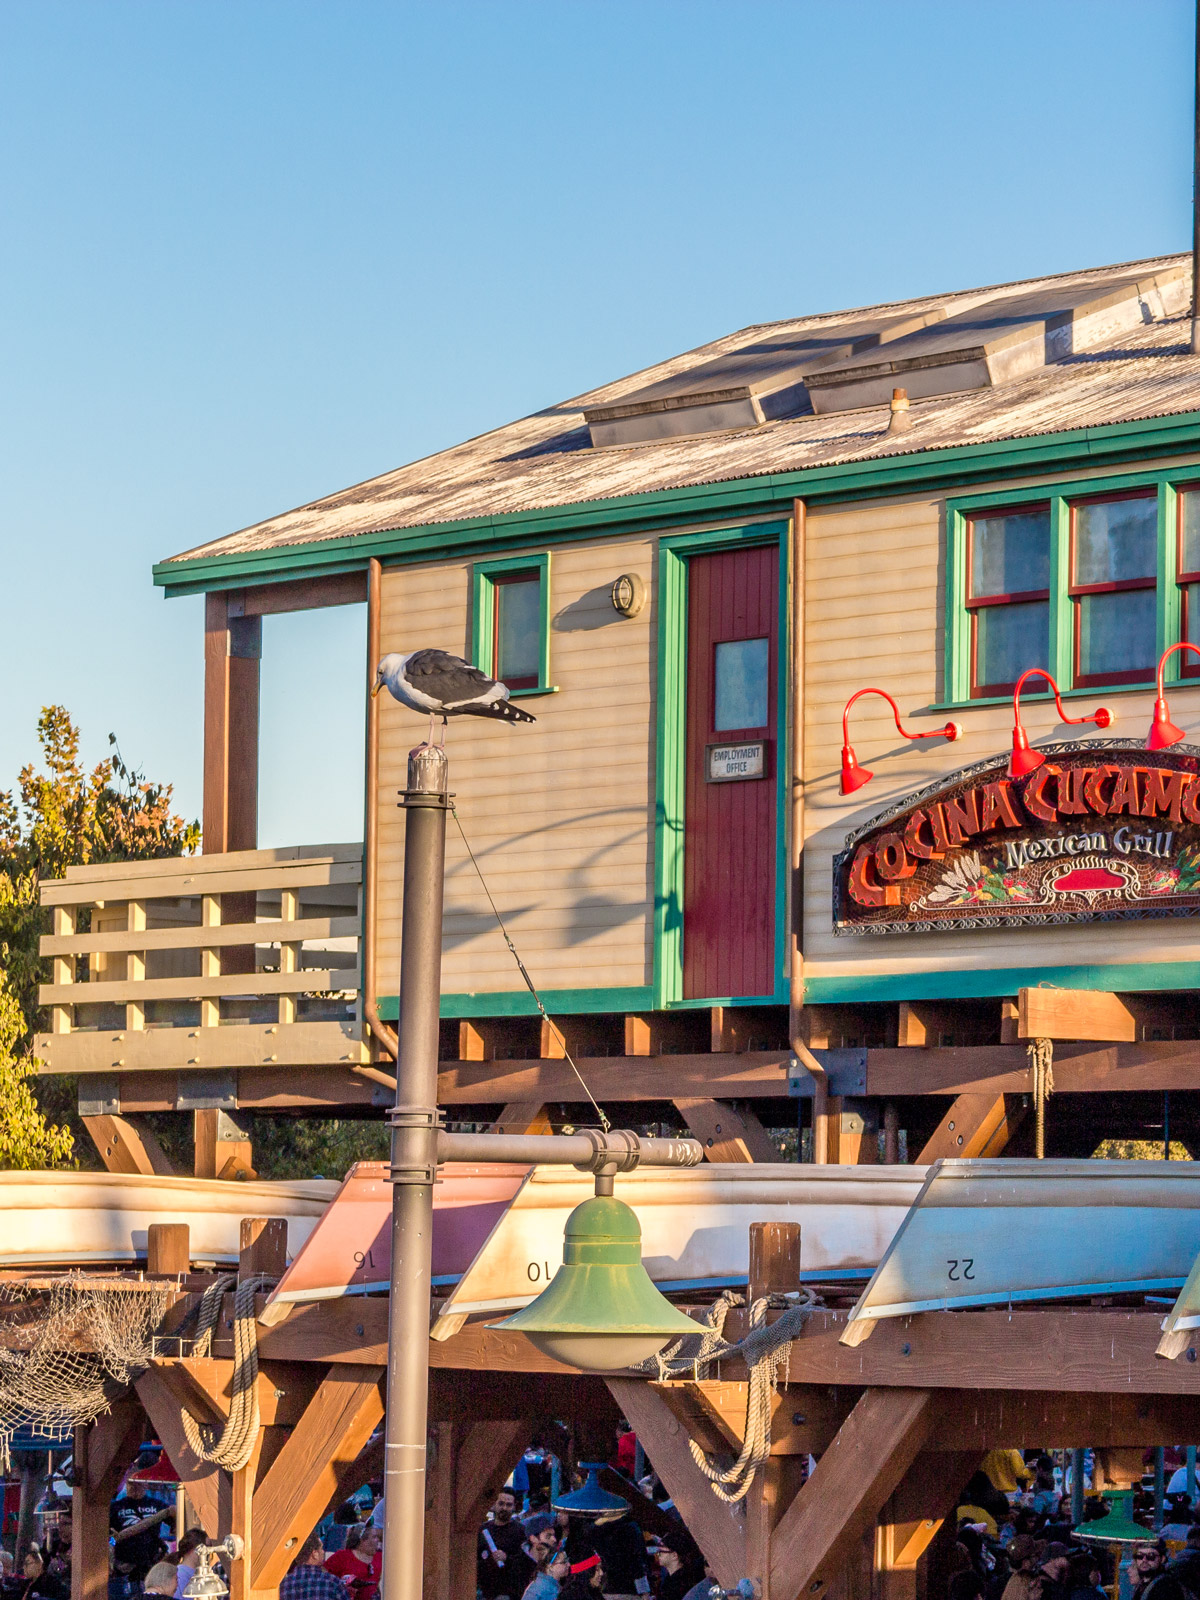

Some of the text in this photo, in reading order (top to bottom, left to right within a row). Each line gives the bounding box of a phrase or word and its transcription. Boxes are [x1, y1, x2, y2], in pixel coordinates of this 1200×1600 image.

[714, 746, 760, 762] EMPLOYMENT
[726, 761, 747, 773] OFFICE
[848, 779, 1022, 907] COCINA
[1004, 826, 1176, 870] Mexican Grill
[946, 1258, 976, 1282] 22
